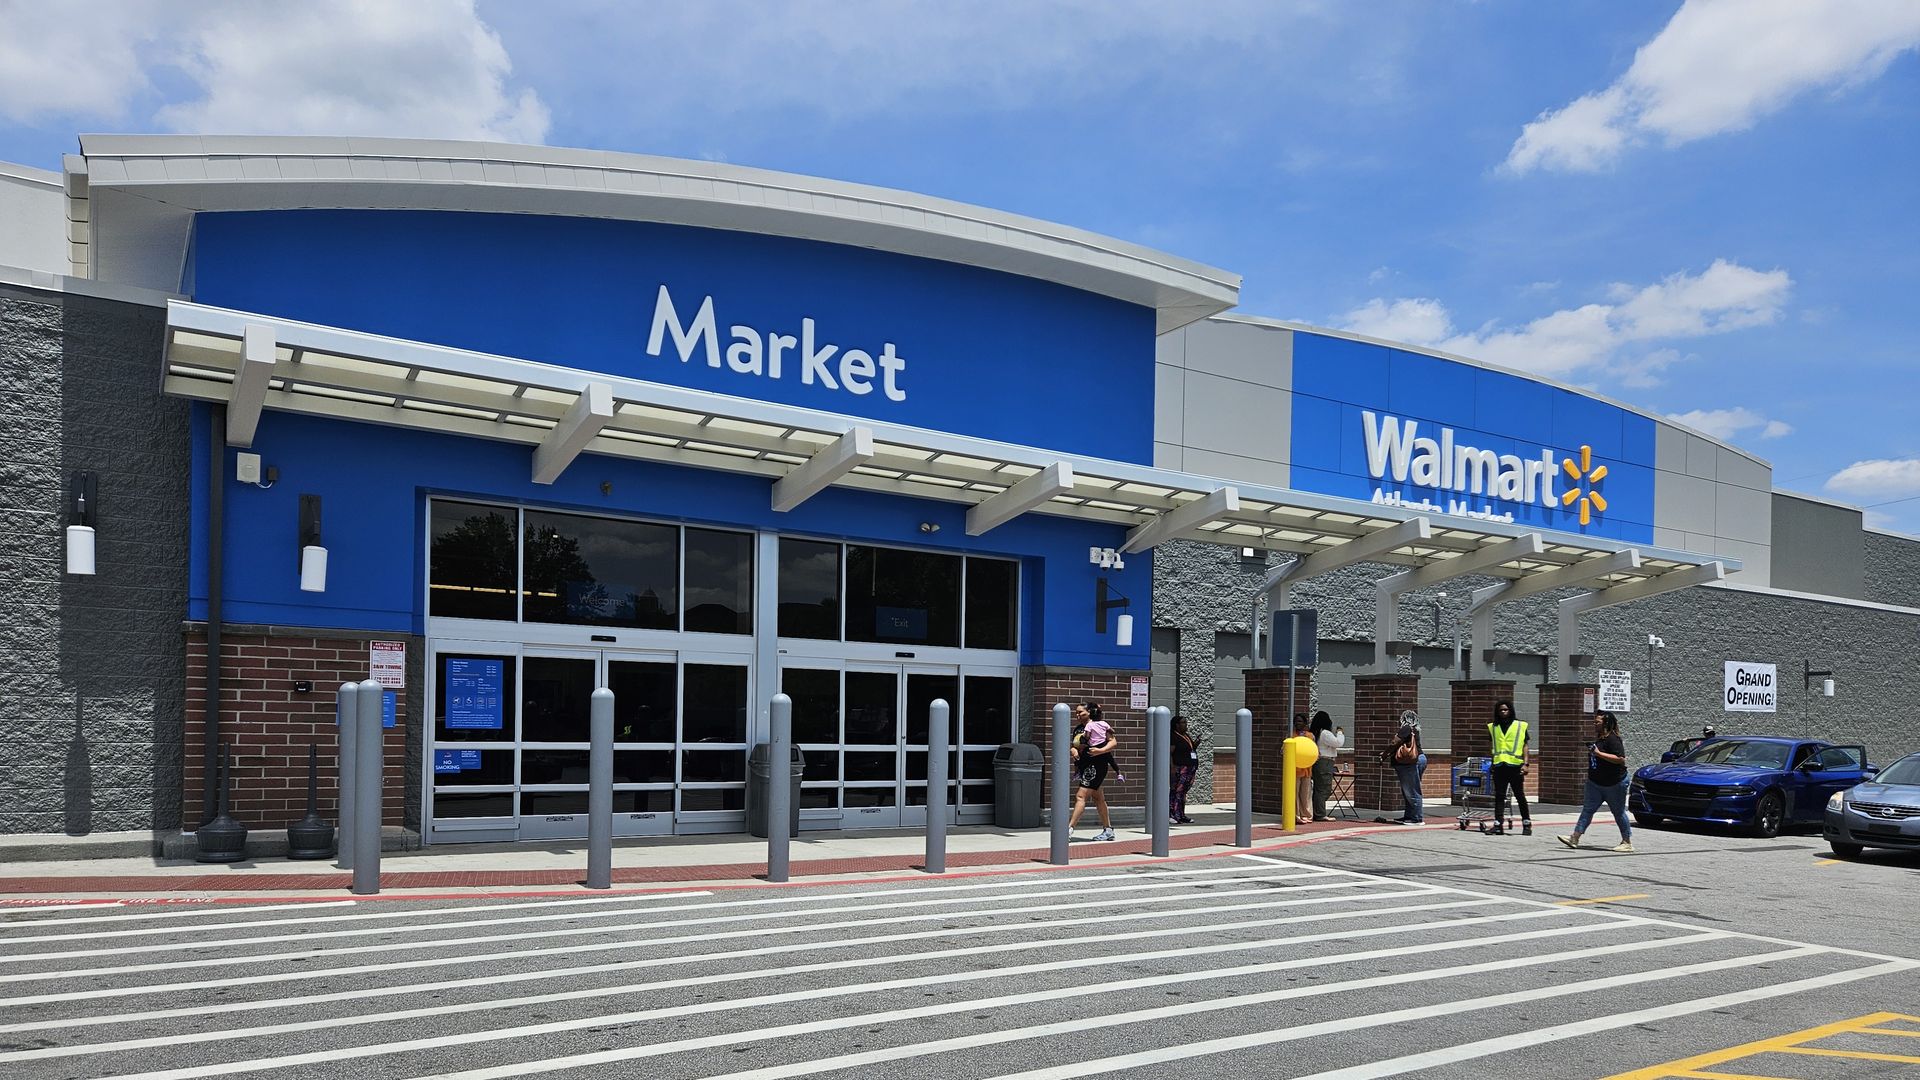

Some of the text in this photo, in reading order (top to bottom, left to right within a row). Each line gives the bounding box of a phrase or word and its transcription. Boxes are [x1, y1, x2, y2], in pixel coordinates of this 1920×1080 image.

[646, 284, 906, 401] Market
[1362, 410, 1559, 508] Walmart
[579, 593, 625, 607] Welcome
[1736, 668, 1771, 687] GRAND
[1727, 687, 1774, 706] OPENING!
